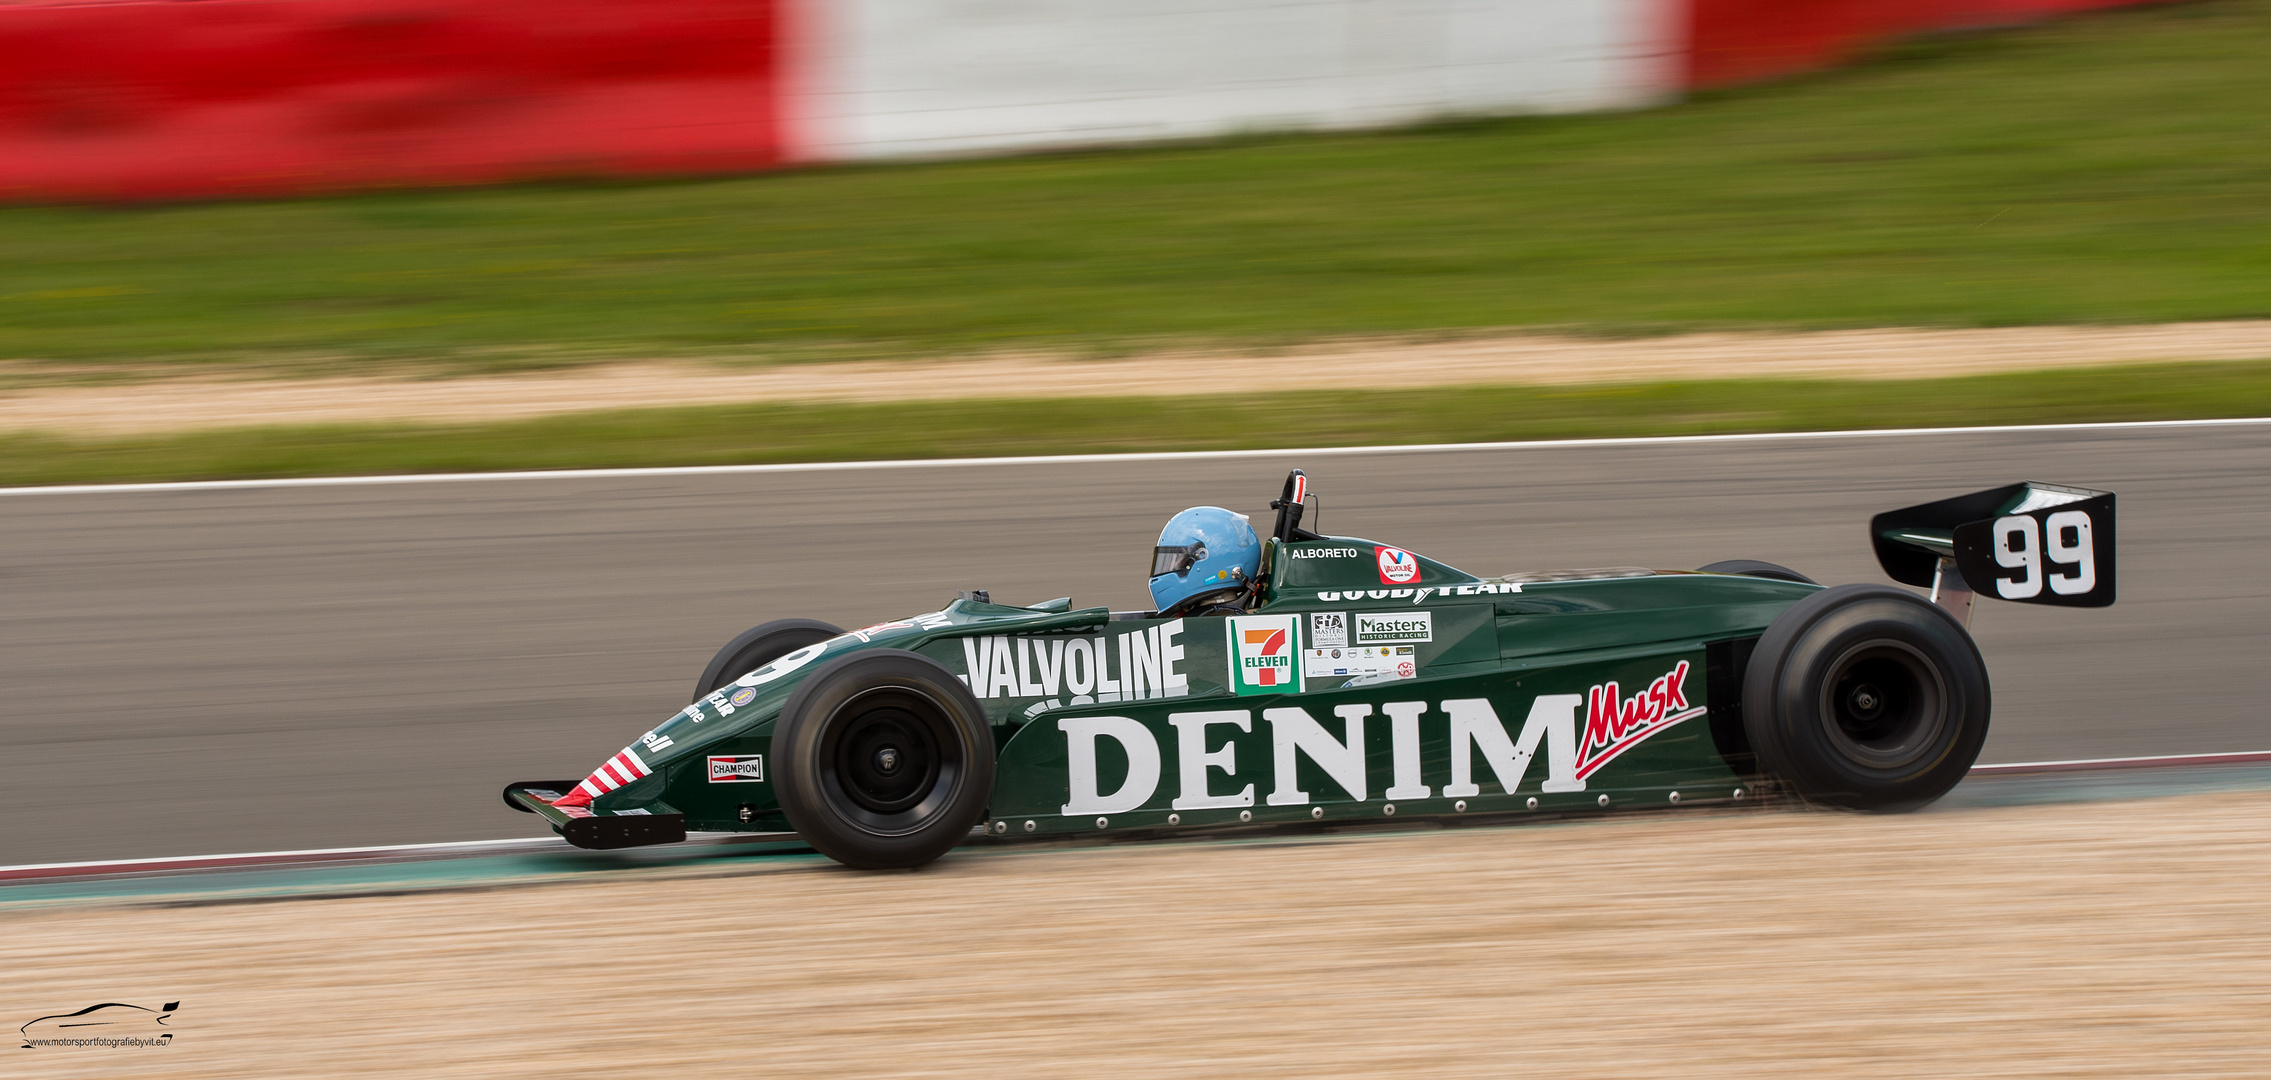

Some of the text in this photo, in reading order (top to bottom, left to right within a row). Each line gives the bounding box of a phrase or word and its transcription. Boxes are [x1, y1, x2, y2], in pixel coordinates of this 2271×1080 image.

[1292, 548, 1357, 559] ALBORETO
[1993, 510, 2096, 600] 99
[1384, 564, 1413, 573] VALVOLINE
[1360, 618, 1427, 632] Masters
[962, 618, 1188, 698] VALVOLINE
[1057, 693, 1586, 817] DENIM
[713, 764, 757, 774] CHAMPION
